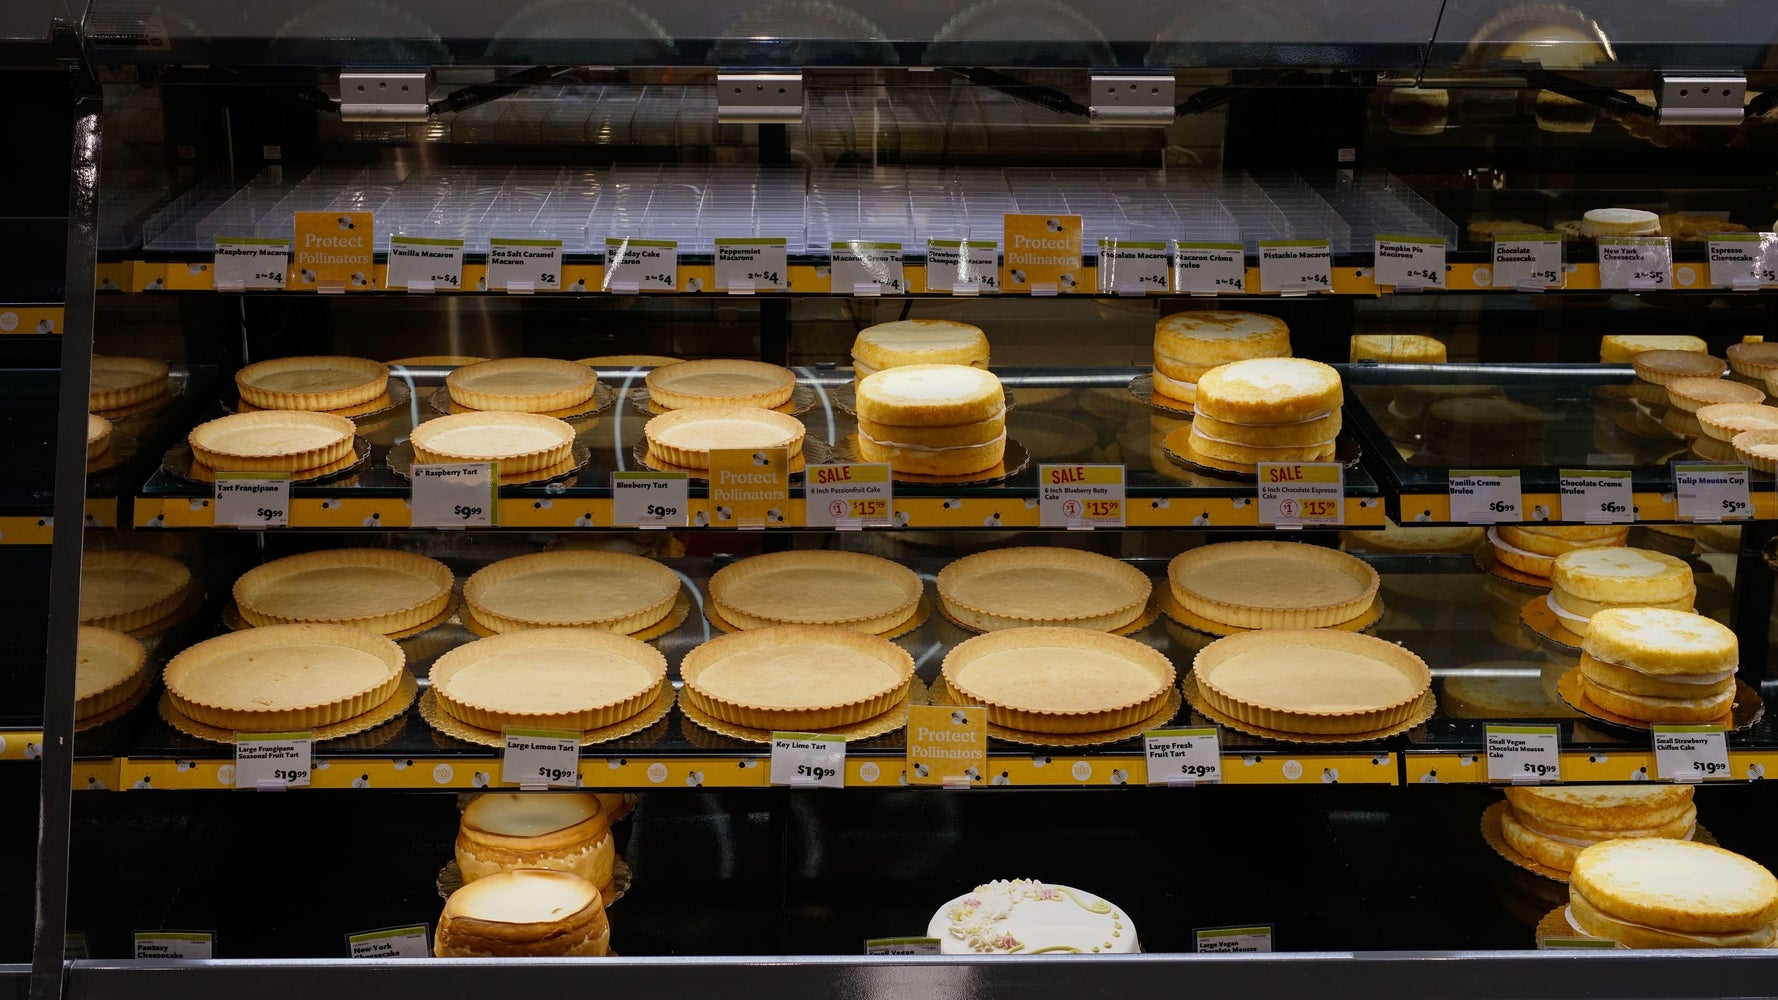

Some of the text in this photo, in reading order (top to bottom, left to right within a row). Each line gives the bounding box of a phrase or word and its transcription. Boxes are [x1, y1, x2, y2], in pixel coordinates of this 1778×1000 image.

[305, 233, 363, 248] Protect
[1014, 234, 1071, 250] Protect
[393, 249, 419, 257] Vanilla
[719, 248, 760, 256] Peppermint
[1380, 245, 1410, 253] Pumpkin
[1711, 247, 1742, 255] Espresso
[300, 252, 369, 264] Pollinators
[1008, 252, 1079, 265] Pollinators
[1264, 251, 1298, 259] Pistachio
[1380, 251, 1413, 259] Macarons
[269, 272, 282, 283] $4
[444, 275, 458, 285] $4
[541, 273, 555, 283] $2
[659, 274, 672, 285] $4
[763, 271, 778, 284] $4
[1153, 275, 1166, 286] $4
[1315, 274, 1328, 285] $4
[1422, 269, 1438, 282] $4
[1545, 270, 1556, 282] $5
[1650, 271, 1663, 283] $5
[1763, 270, 1775, 280] $5
[982, 276, 994, 287] $4
[1229, 278, 1242, 289] $4
[425, 469, 461, 477] Raspberry
[720, 470, 778, 484] Protect
[818, 466, 851, 484] SALE
[1051, 467, 1085, 484] SALE
[1270, 466, 1303, 483] SALE
[616, 482, 651, 490] Blueberry
[1677, 477, 1697, 485] Tulip
[1729, 477, 1744, 485] Cup
[235, 484, 278, 493] Frangipane
[714, 489, 784, 500] Pollinators
[918, 727, 976, 743] Protect
[258, 745, 294, 753] Frangipane
[508, 742, 529, 750] Large
[531, 743, 556, 751] Lemon
[911, 746, 983, 759] Pollinators
[373, 943, 392, 951] York
